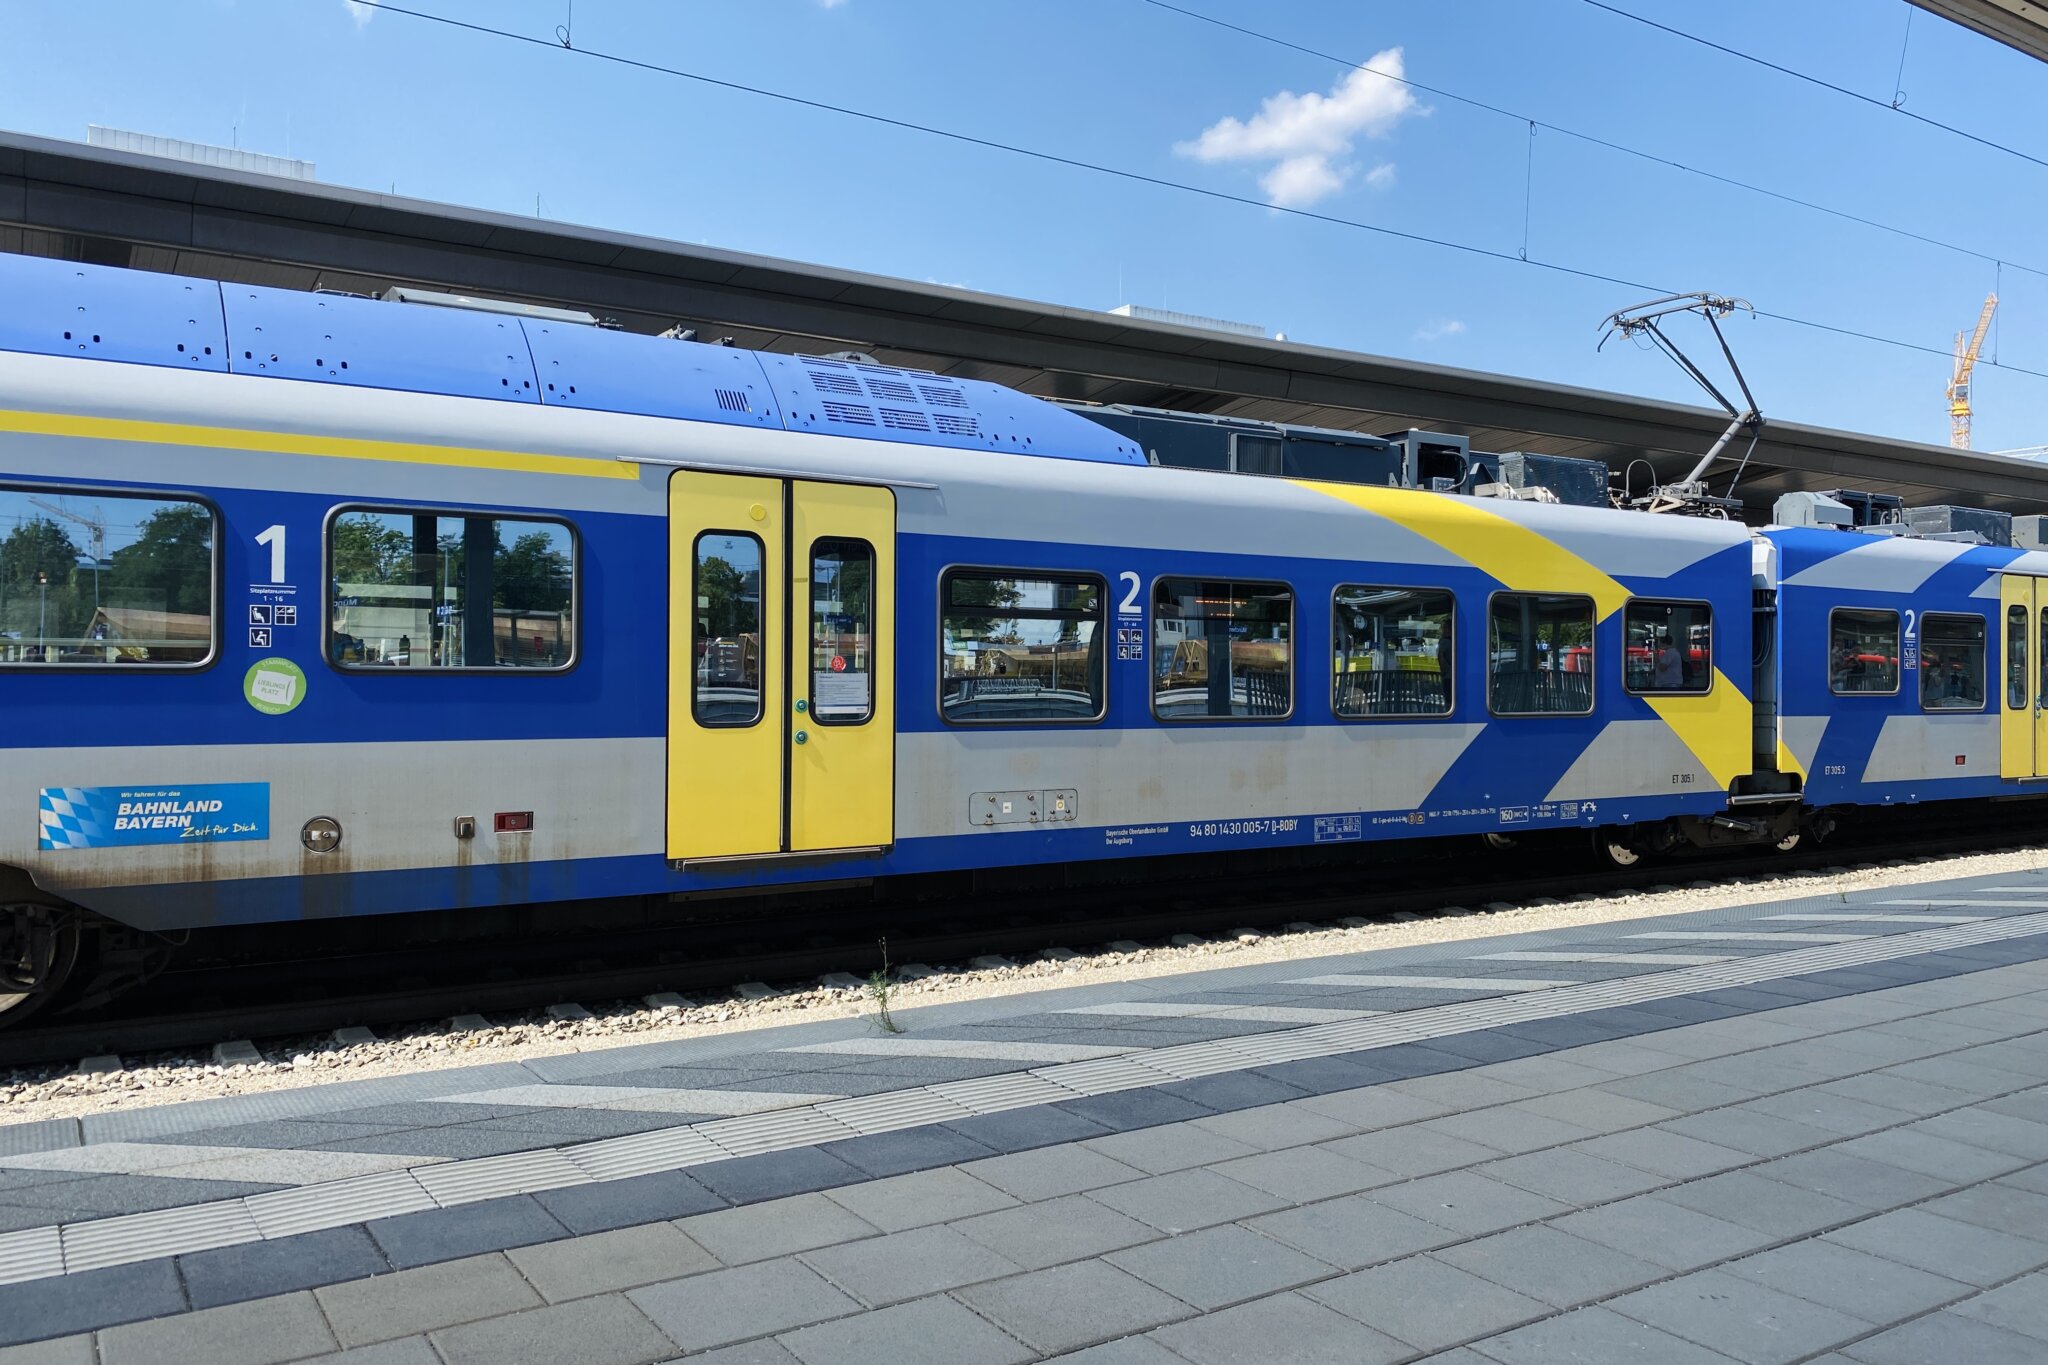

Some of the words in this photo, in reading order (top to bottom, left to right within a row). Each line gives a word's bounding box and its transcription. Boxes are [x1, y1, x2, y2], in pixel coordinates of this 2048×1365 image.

[254, 524, 286, 583] 1
[1118, 571, 1142, 613] 2
[1904, 609, 1916, 638] 2
[1672, 775, 1679, 784] ET
[1680, 773, 1695, 784] 305.1
[157, 790, 168, 798] für
[117, 799, 223, 816] BAHNLAND
[1501, 809, 1513, 821] 160
[114, 815, 192, 831] BAYERN
[179, 825, 211, 838] Zeit
[212, 825, 230, 836] für
[232, 822, 259, 834] Dich.
[1190, 824, 1202, 837] 94
[1204, 823, 1217, 836] 80
[1219, 822, 1241, 835] 1430
[1242, 820, 1270, 834] 005-7
